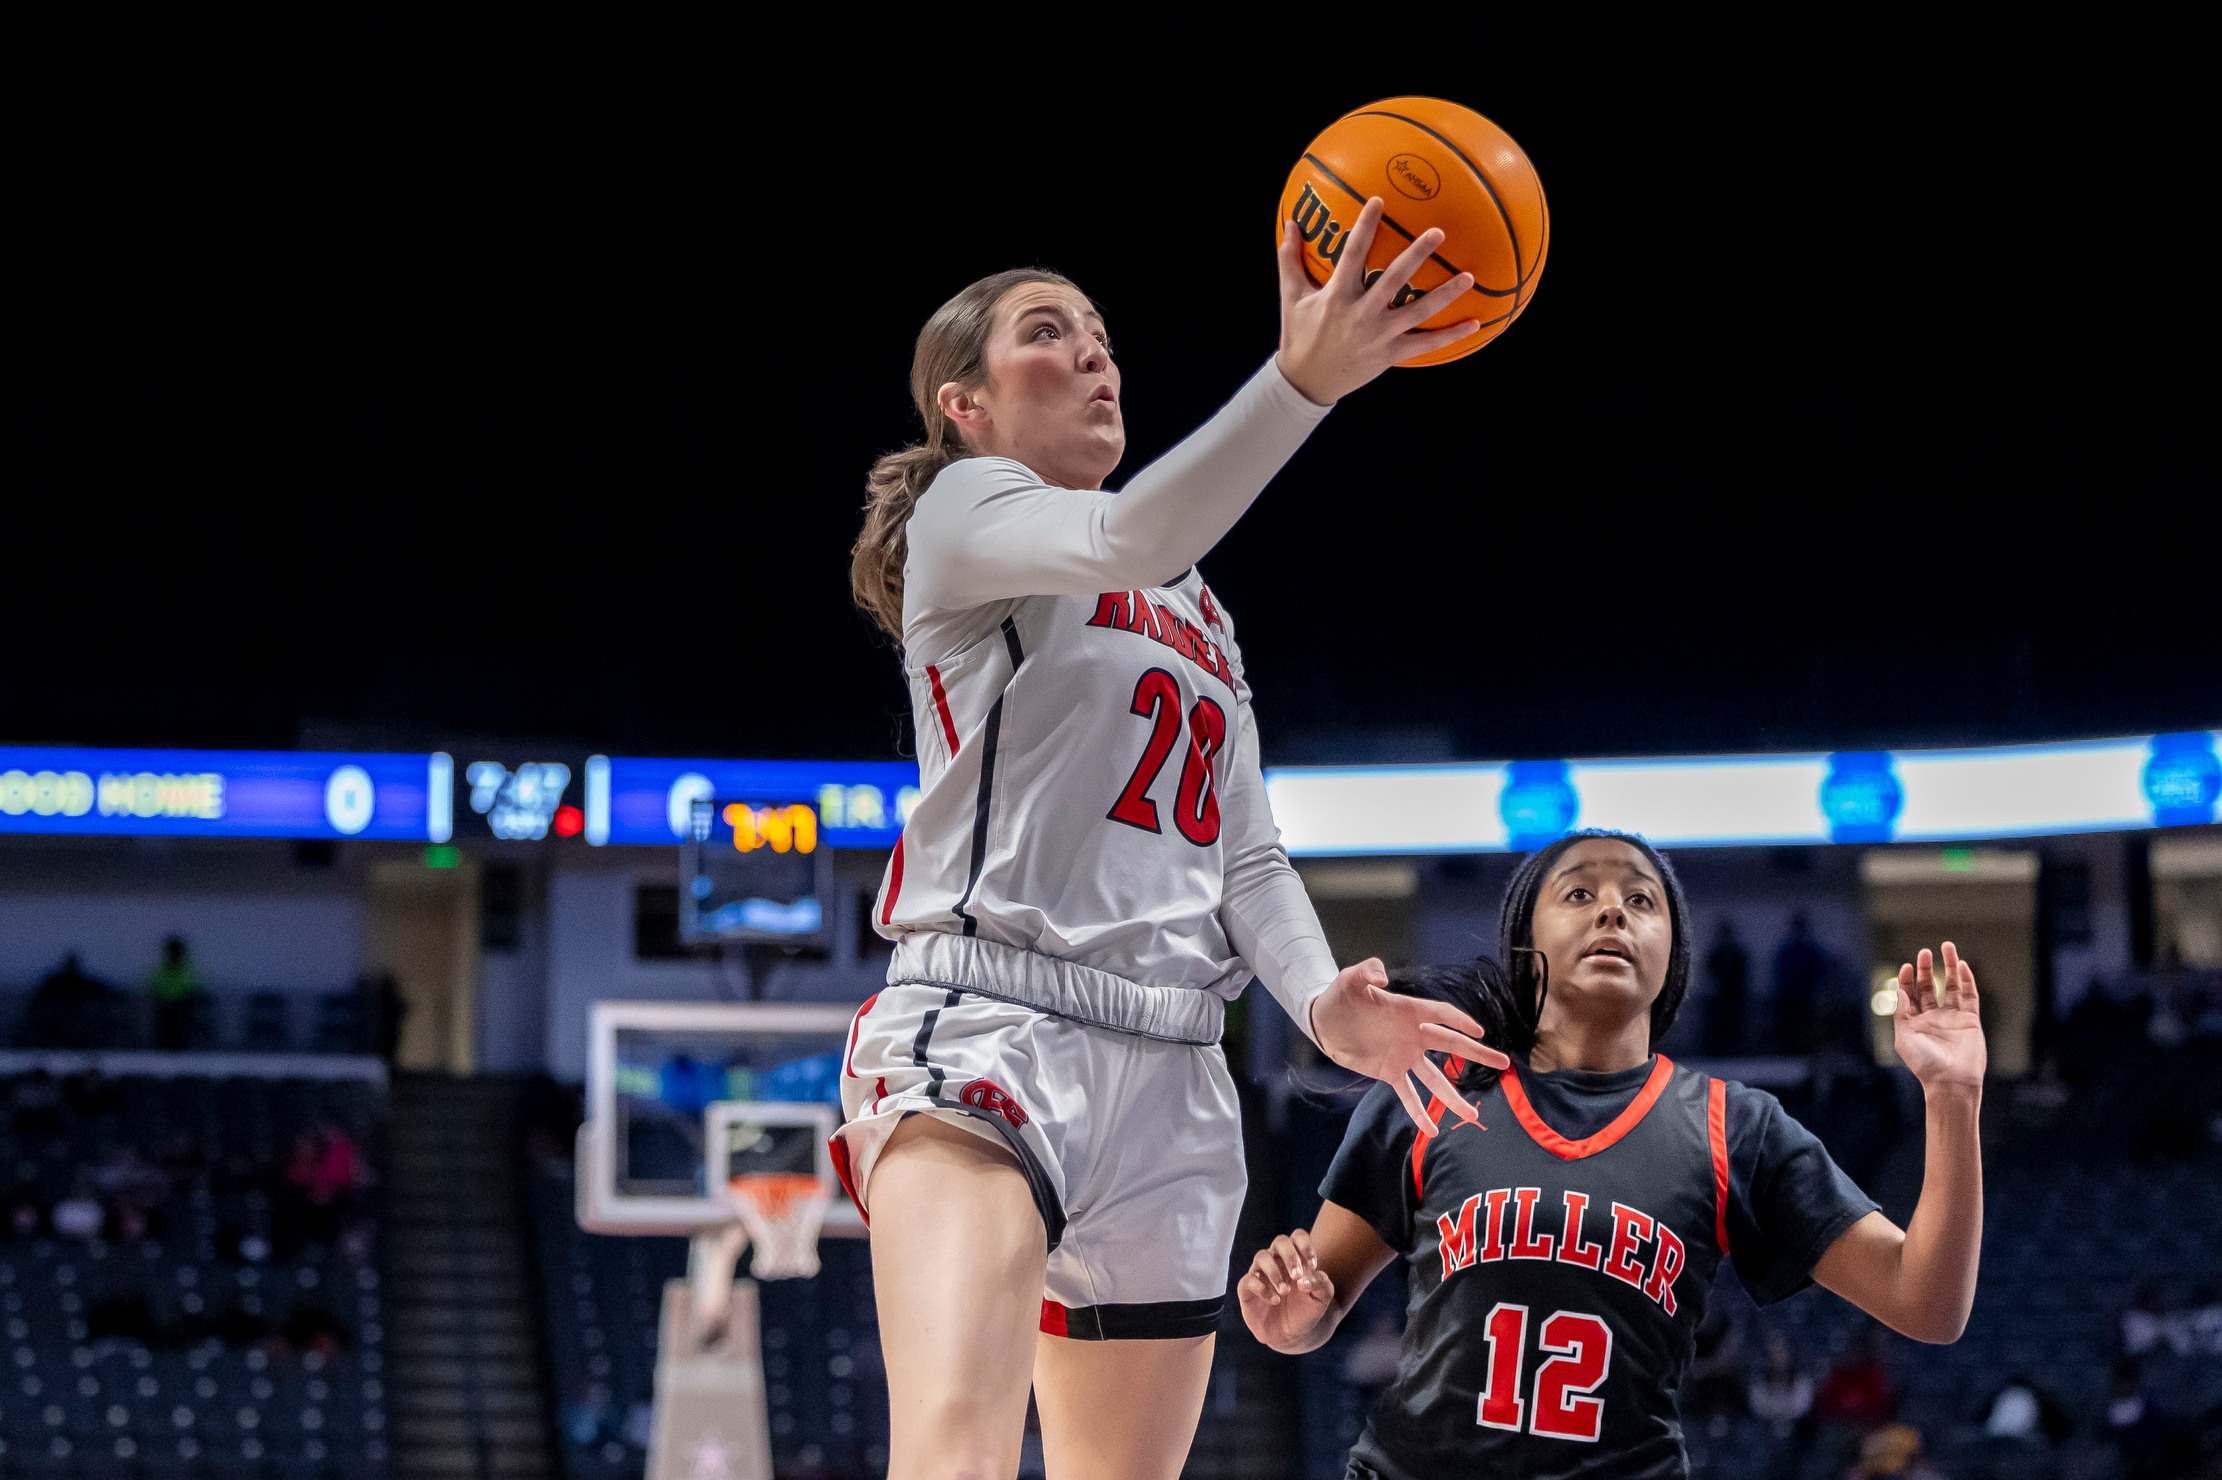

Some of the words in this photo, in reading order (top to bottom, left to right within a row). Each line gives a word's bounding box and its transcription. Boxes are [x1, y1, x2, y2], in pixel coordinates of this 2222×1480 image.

[1291, 180, 1428, 308] Wiln
[1085, 589, 1239, 706] RAIDER
[1106, 666, 1226, 847] 20
[1437, 1186, 1685, 1318] MILLER
[1476, 1302, 1613, 1442] 12
